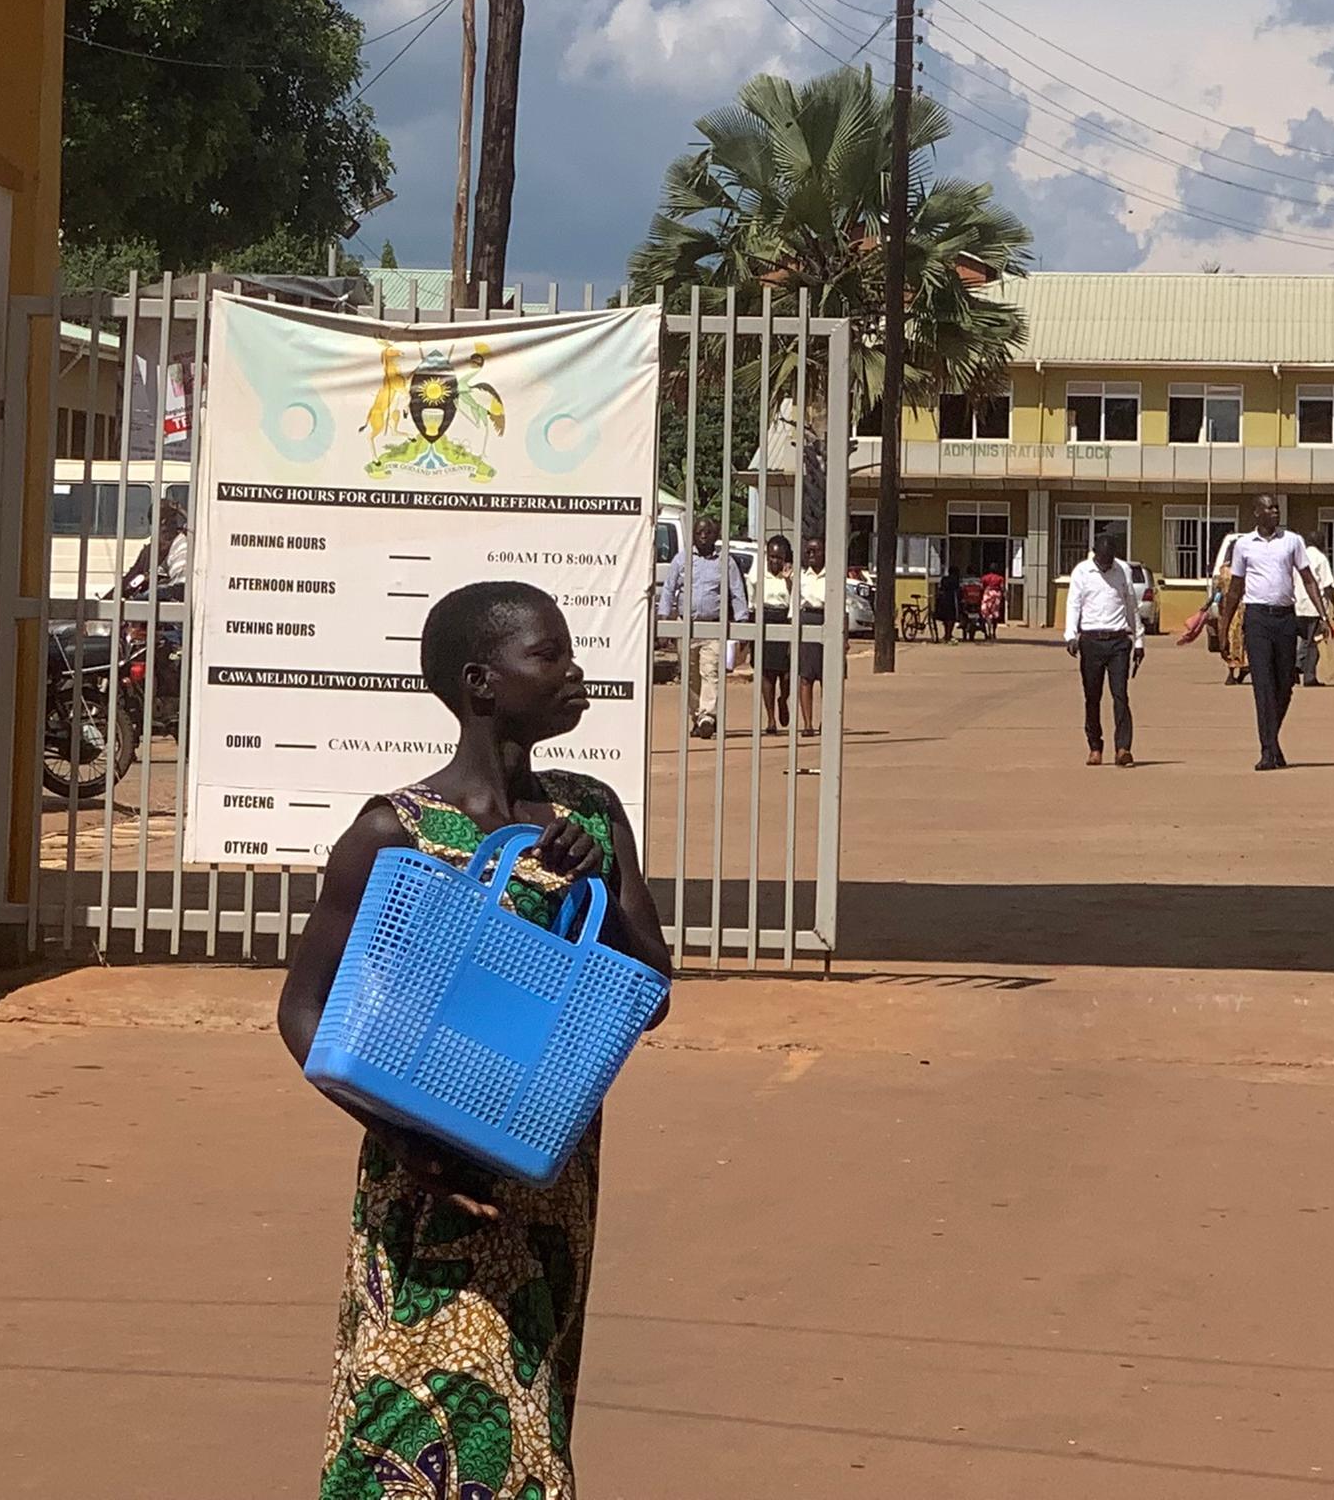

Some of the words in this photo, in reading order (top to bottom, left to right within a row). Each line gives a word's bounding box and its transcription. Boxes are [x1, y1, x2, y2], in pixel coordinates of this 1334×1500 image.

[944, 443, 1055, 459] ADMINISTRATION
[1066, 444, 1113, 460] BLOCK
[221, 485, 284, 499] VISITING
[287, 488, 335, 501] HOURS
[339, 490, 367, 503] FOR
[370, 492, 410, 505] GULU
[413, 494, 488, 508] REGIONAL
[490, 496, 566, 510] REFERRAL
[569, 498, 639, 512] HOSPITAL
[230, 533, 284, 548] MORNING
[287, 536, 326, 550] HOURS
[487, 551, 538, 564] 6:00AM
[542, 552, 563, 564] TO
[566, 553, 617, 566] 8:00AM
[228, 577, 294, 592] AFTERNOON
[296, 580, 336, 594] HOURS
[562, 594, 612, 607] 2:00PM
[226, 620, 273, 635] EVENING
[276, 622, 315, 637] HOURS
[574, 636, 611, 648] 30PM
[218, 670, 253, 684] CAWA
[256, 672, 308, 686] MELIMO
[310, 674, 356, 688] LUTWO
[359, 675, 399, 689] OTYAT
[401, 678, 428, 690] GUL
[584, 684, 627, 697] SPITAL
[226, 734, 261, 748] ODIKO
[328, 738, 370, 752] CAWA
[533, 746, 575, 759] CAWA
[578, 748, 621, 761] ARYO
[223, 794, 274, 809] DYECENG
[224, 841, 268, 855] OTYENO
